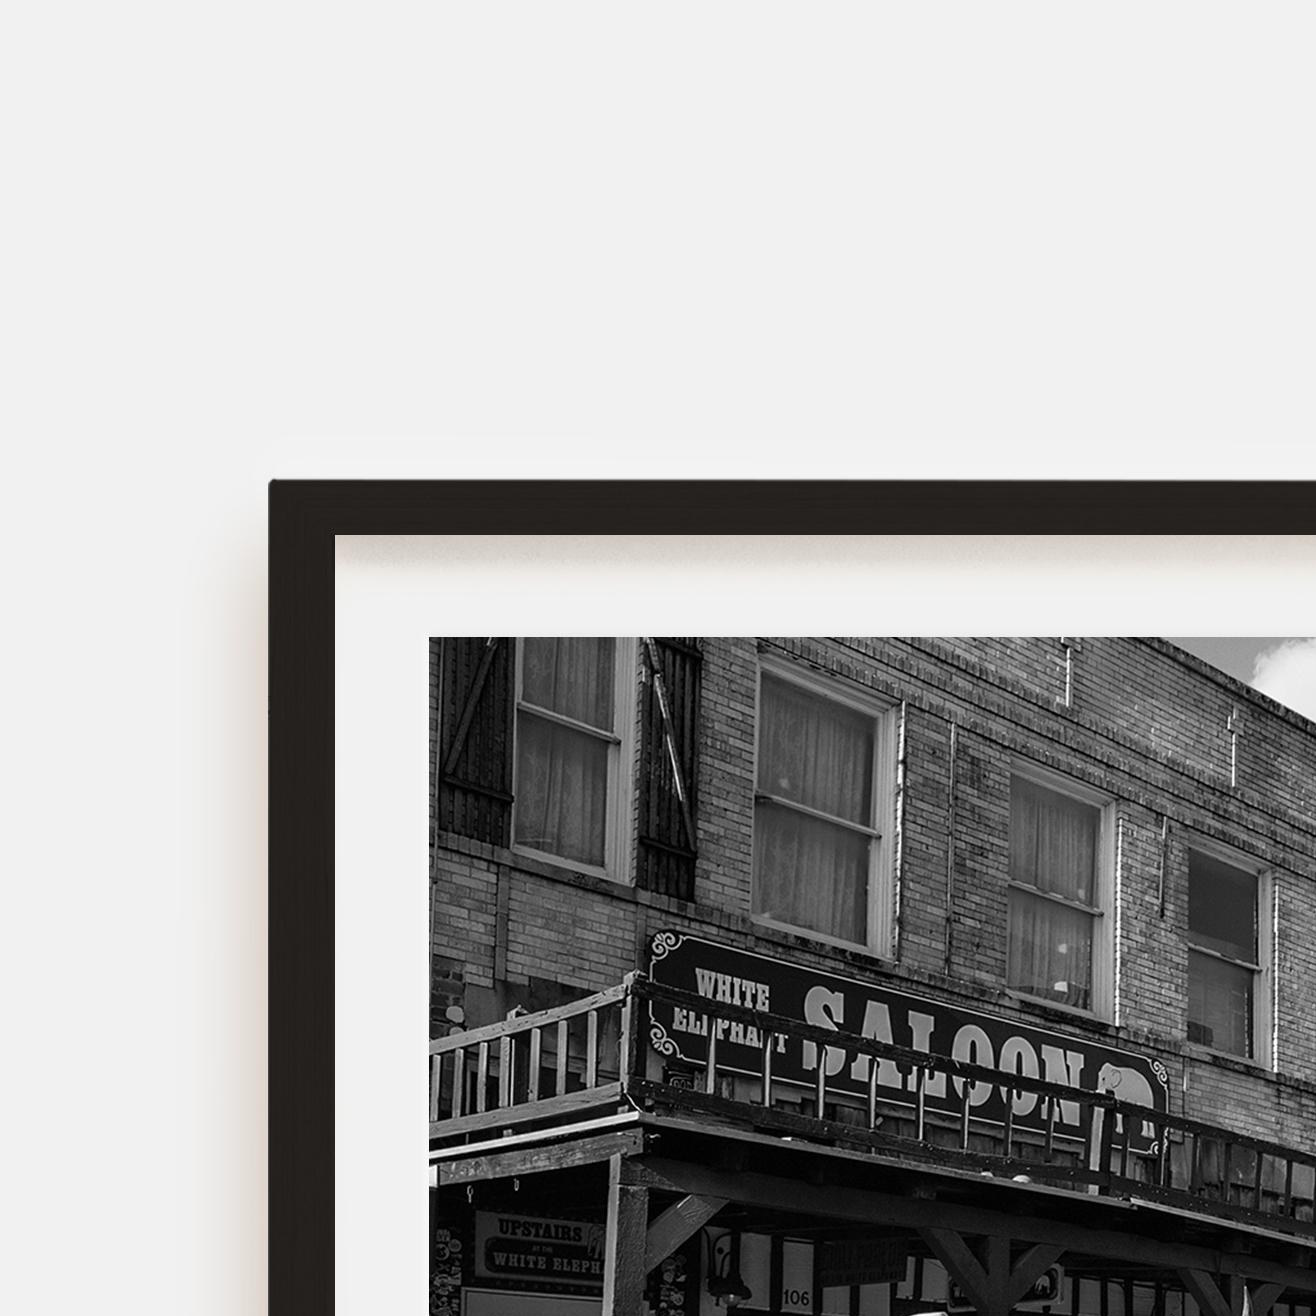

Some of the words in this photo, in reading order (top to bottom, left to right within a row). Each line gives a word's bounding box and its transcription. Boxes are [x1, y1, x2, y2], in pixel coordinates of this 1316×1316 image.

[695, 967, 770, 1012] WHITE
[802, 985, 1085, 1127] SALOON
[498, 1218, 583, 1242] UPSTAIRS
[493, 1252, 546, 1270] WHITE
[553, 1257, 604, 1274] ELEPH
[784, 1289, 810, 1306] 106
